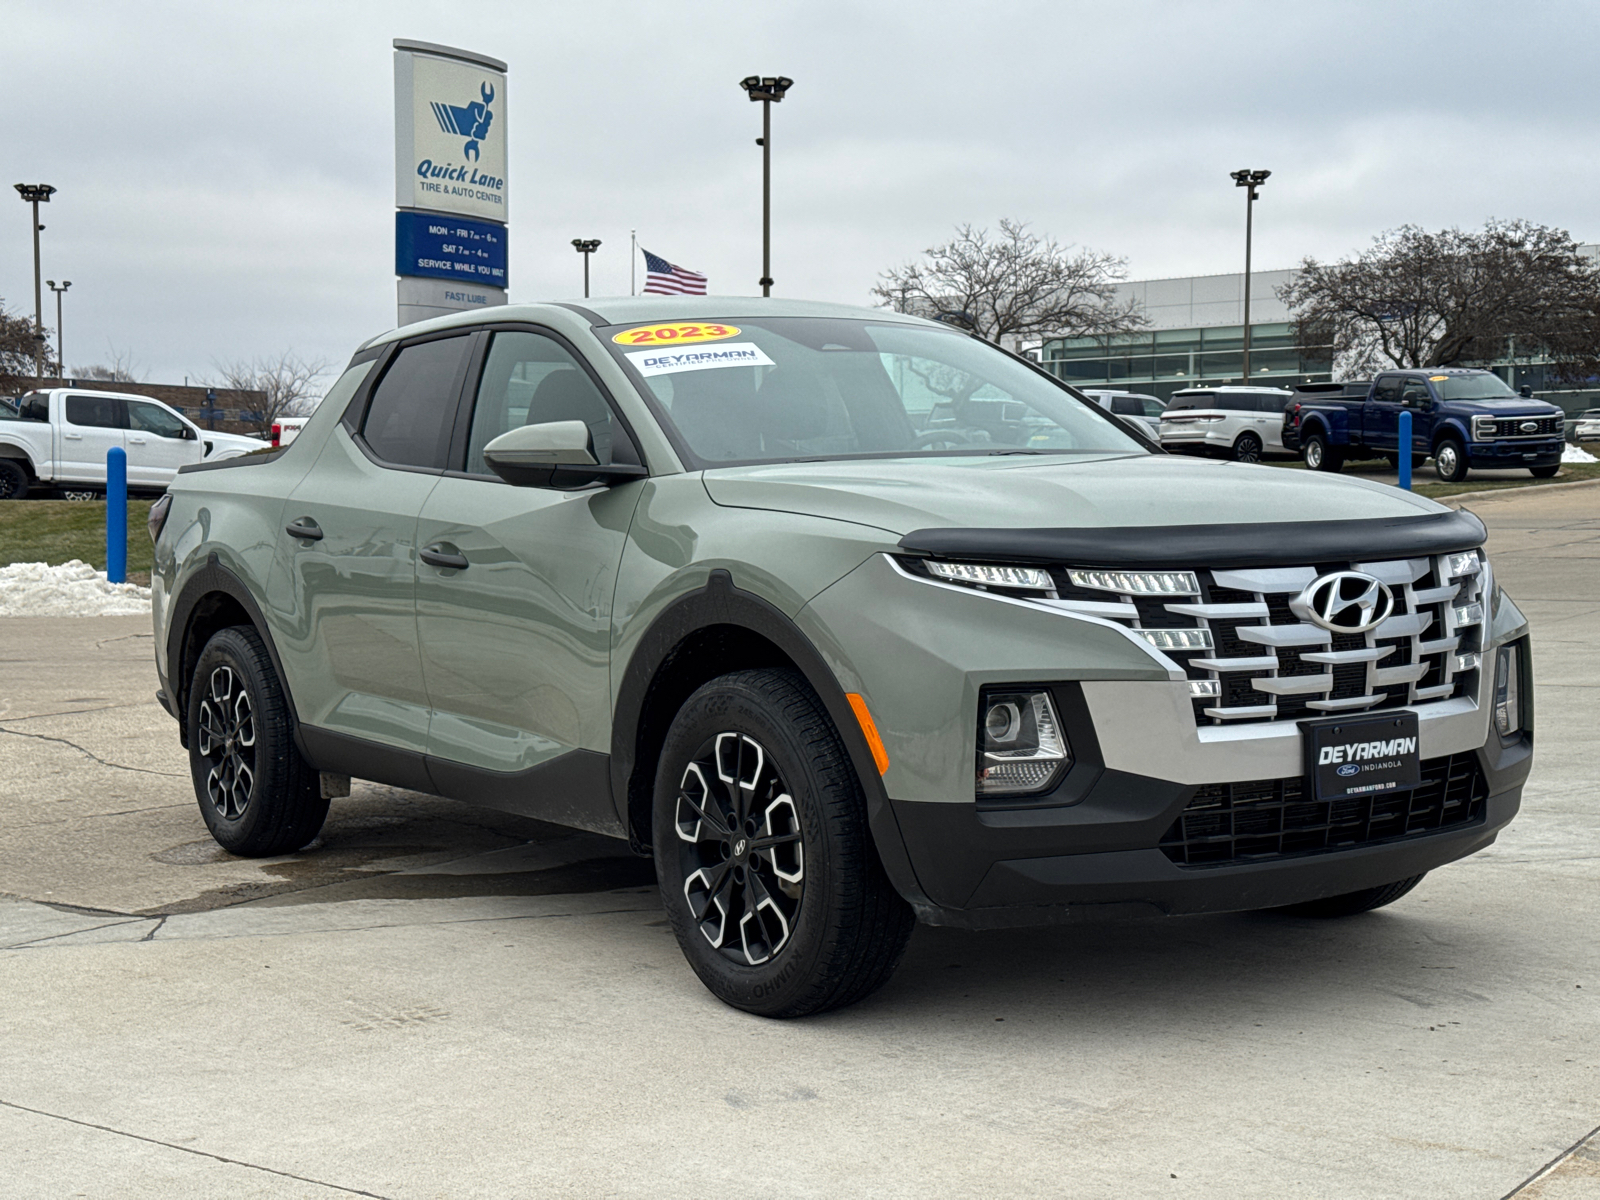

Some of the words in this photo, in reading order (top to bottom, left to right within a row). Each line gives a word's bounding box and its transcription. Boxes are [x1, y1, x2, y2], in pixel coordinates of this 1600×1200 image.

[417, 159, 469, 182] Quick
[469, 168, 504, 190] Lane
[420, 181, 441, 193] TIRE
[443, 184, 450, 194] &
[451, 186, 474, 198] AUTO
[475, 190, 503, 205] CENTER
[428, 225, 448, 235] MON
[456, 228, 468, 238] FRI
[442, 243, 457, 254] SAT
[418, 258, 452, 270] SERVICE
[453, 262, 476, 273] WHILE
[477, 265, 491, 275] YOU
[491, 267, 505, 278] WAIT
[445, 291, 466, 302] FAST
[467, 294, 488, 305] LUBE
[630, 325, 730, 344] 2023
[643, 350, 756, 367] DEYARMAN
[655, 359, 703, 369] CERTIFIED
[1319, 736, 1417, 766] DEYARMAN
[1361, 760, 1402, 772] INDIANOLA
[1347, 782, 1396, 794] DEYARMANFORD.COM
[752, 948, 804, 998] KUMHO
